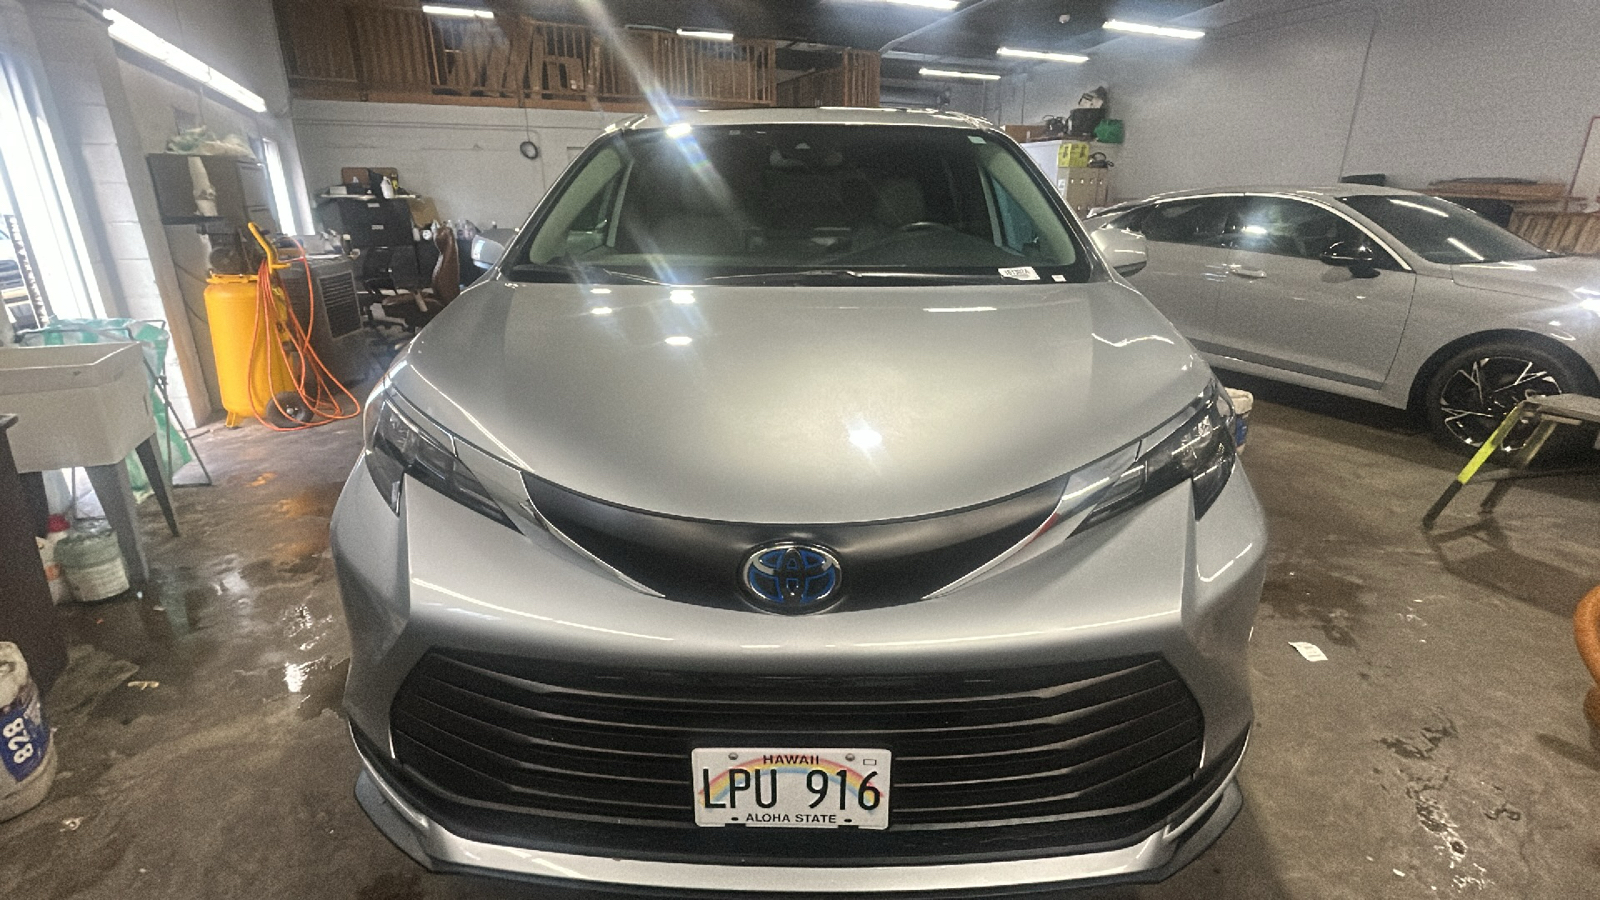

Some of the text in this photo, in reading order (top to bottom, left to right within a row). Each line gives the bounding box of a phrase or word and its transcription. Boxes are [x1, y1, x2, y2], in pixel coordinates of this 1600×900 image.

[763, 755, 820, 765] HAWAII
[702, 768, 881, 811] LPU 916
[745, 813, 837, 824] ALOHA STATE
